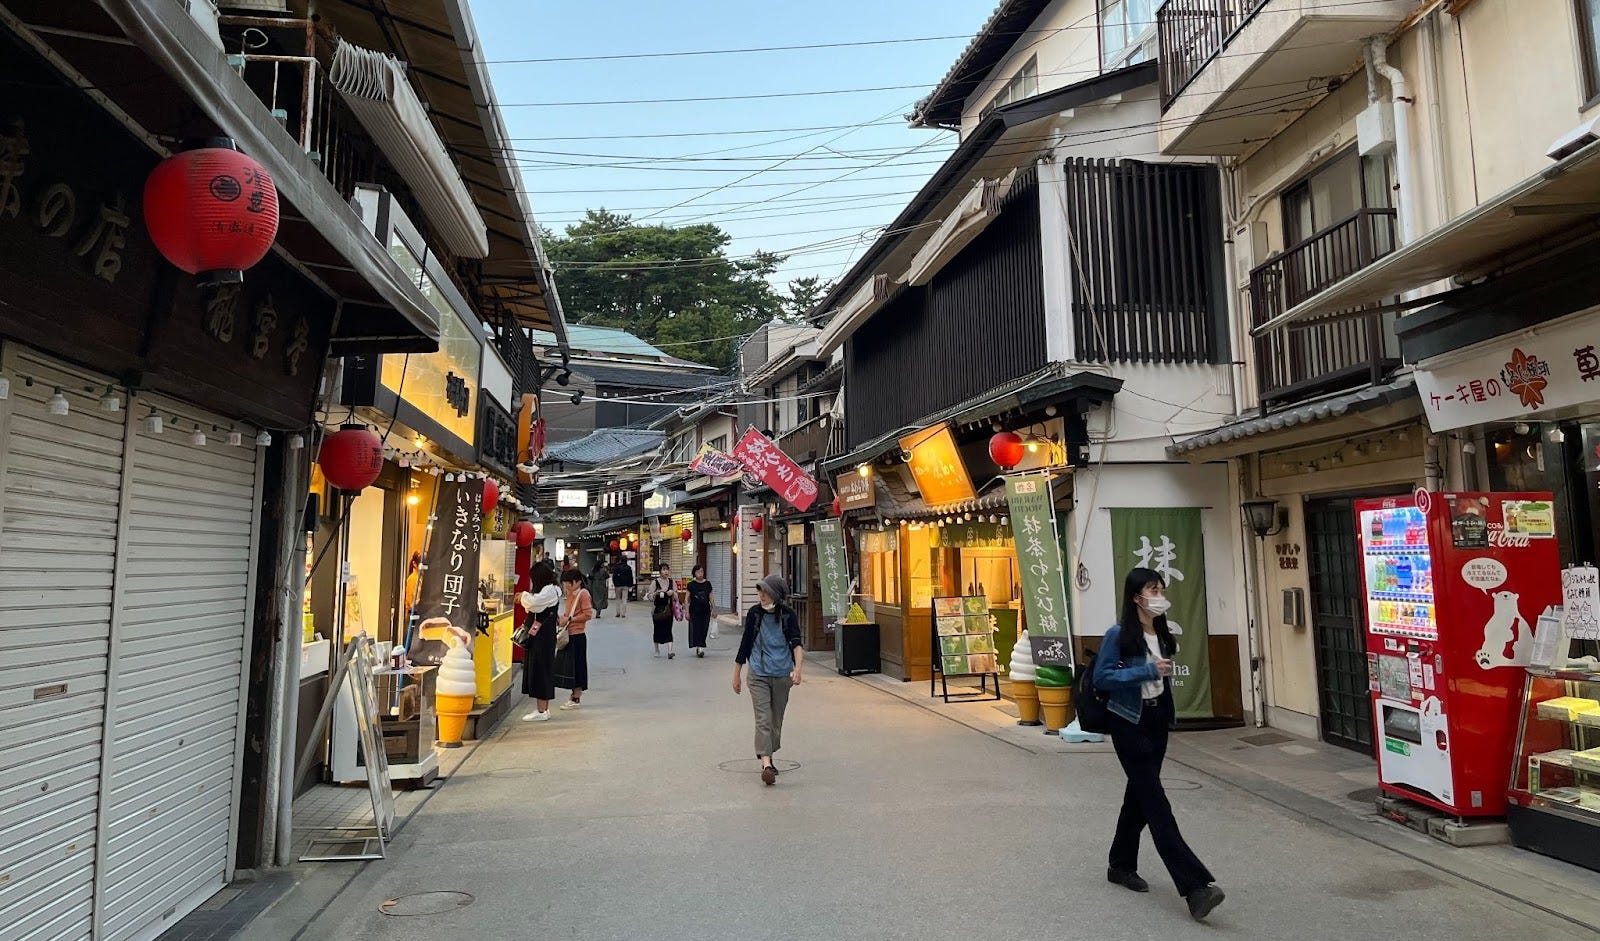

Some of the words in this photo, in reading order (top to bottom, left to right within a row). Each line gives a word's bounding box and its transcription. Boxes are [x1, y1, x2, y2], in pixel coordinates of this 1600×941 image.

[1429, 378, 1502, 411] ケーキ屋の
[1499, 360, 1551, 387] もみじ饅頭
[440, 487, 471, 616] いきなり団子
[471, 493, 482, 552] はちみつ入り
